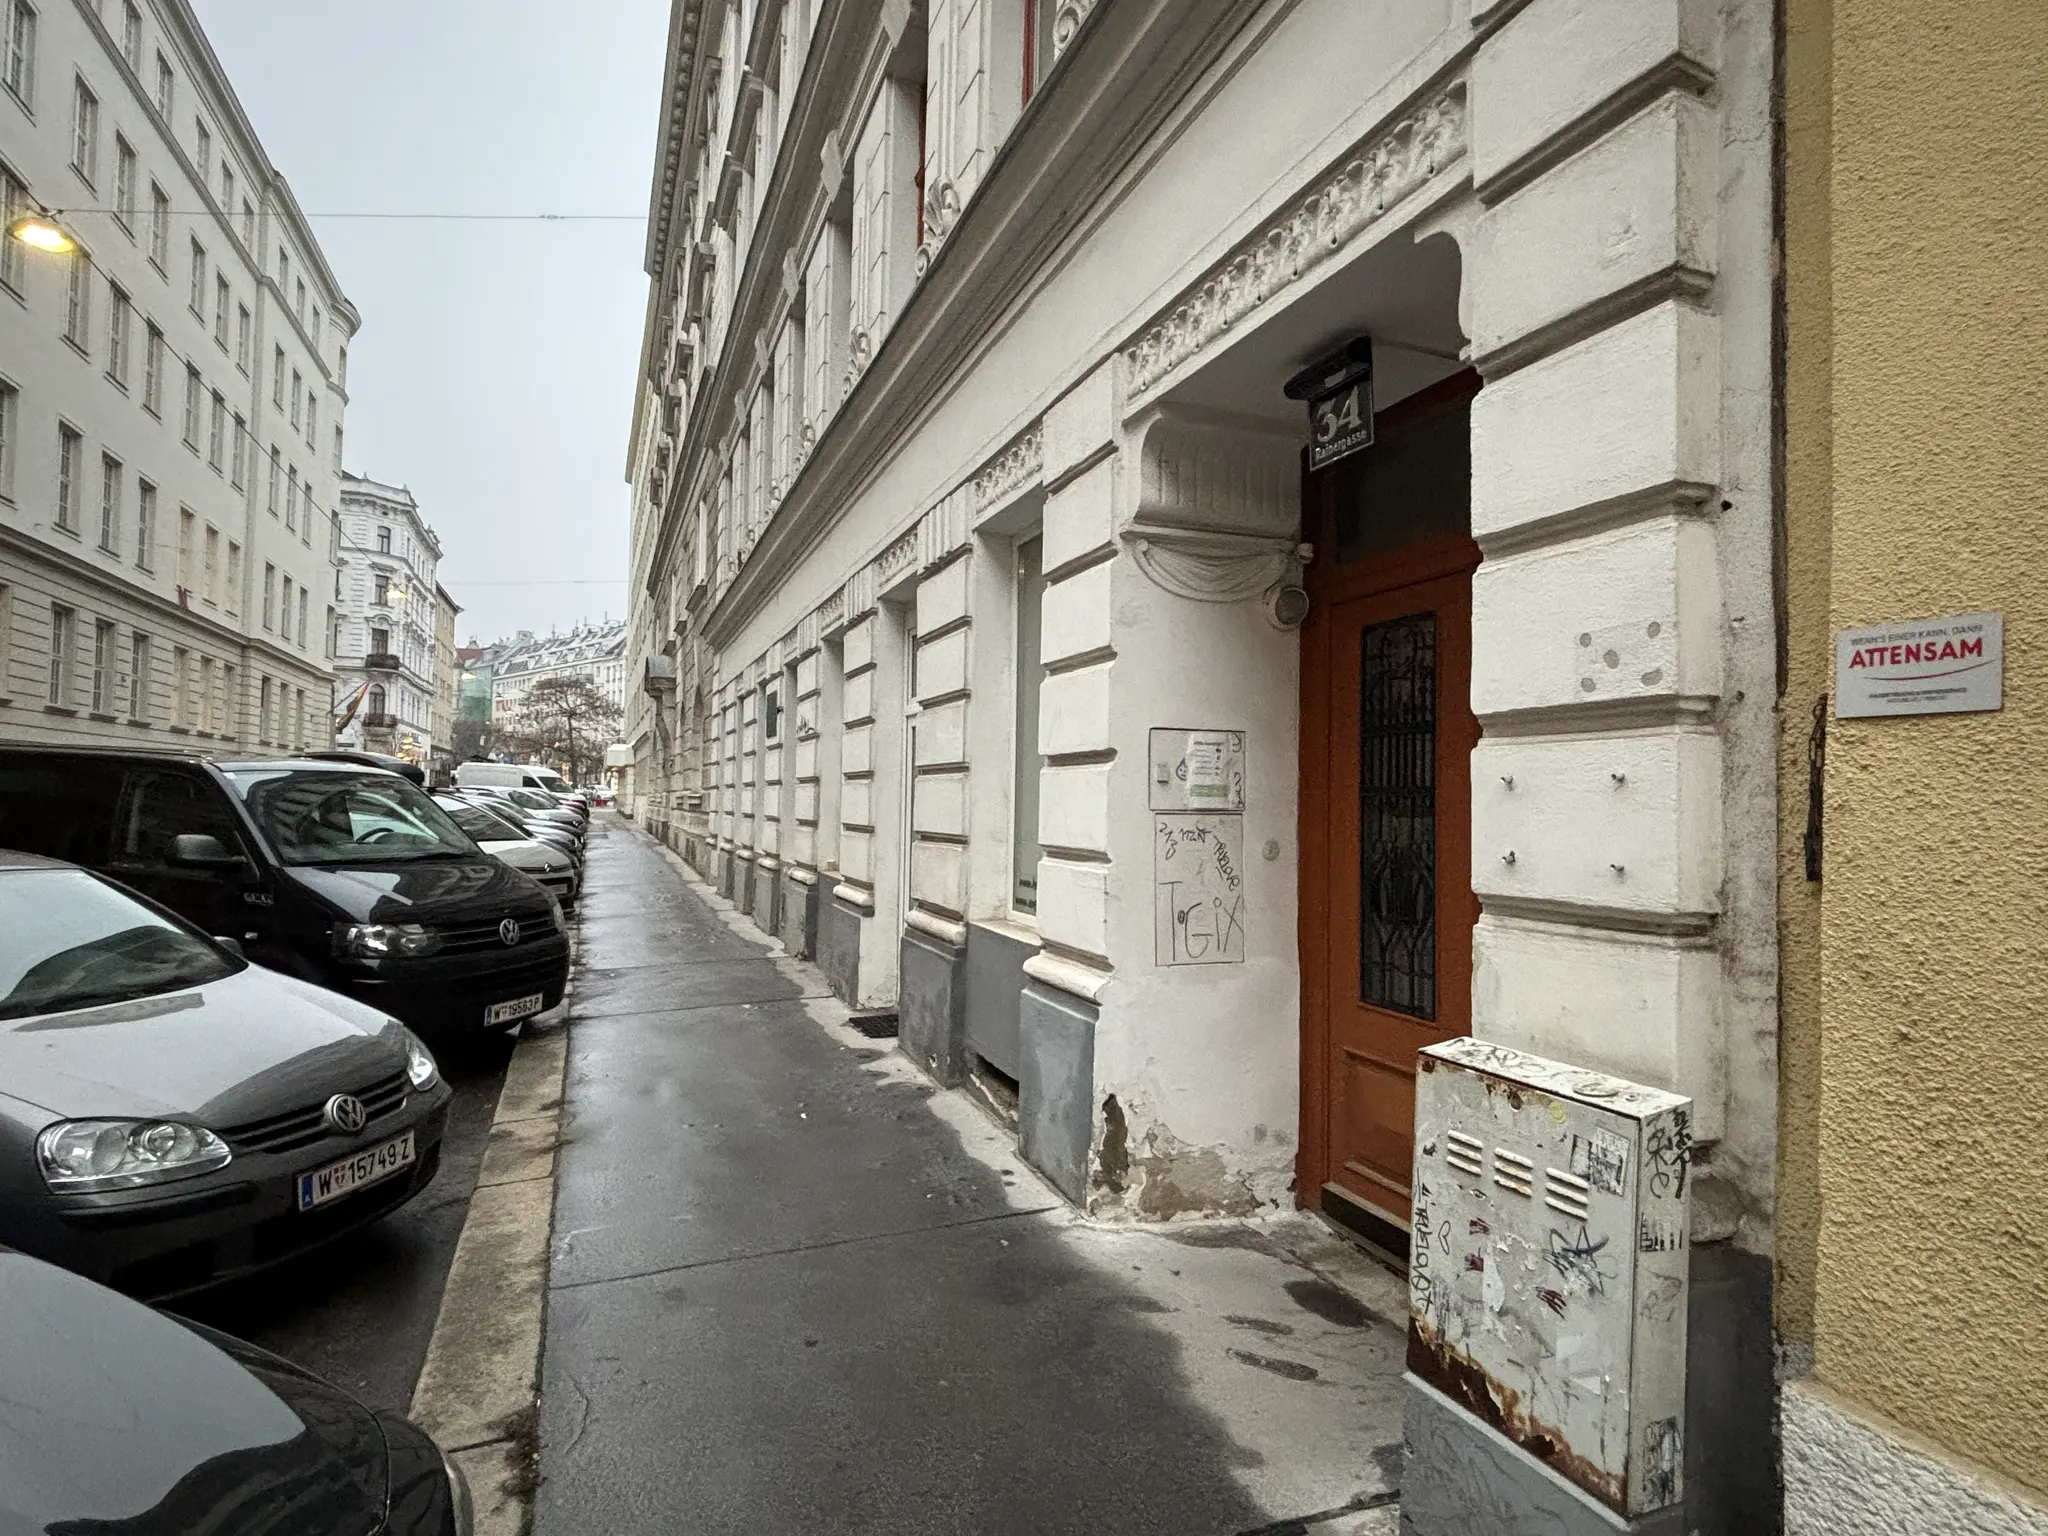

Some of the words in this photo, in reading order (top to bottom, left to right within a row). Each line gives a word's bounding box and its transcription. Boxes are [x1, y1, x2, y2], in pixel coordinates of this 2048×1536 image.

[1316, 386, 1362, 443] 34
[1849, 637, 1984, 669] ATTENSAM
[318, 1170, 332, 1197] W
[400, 1137, 411, 1161] Z
